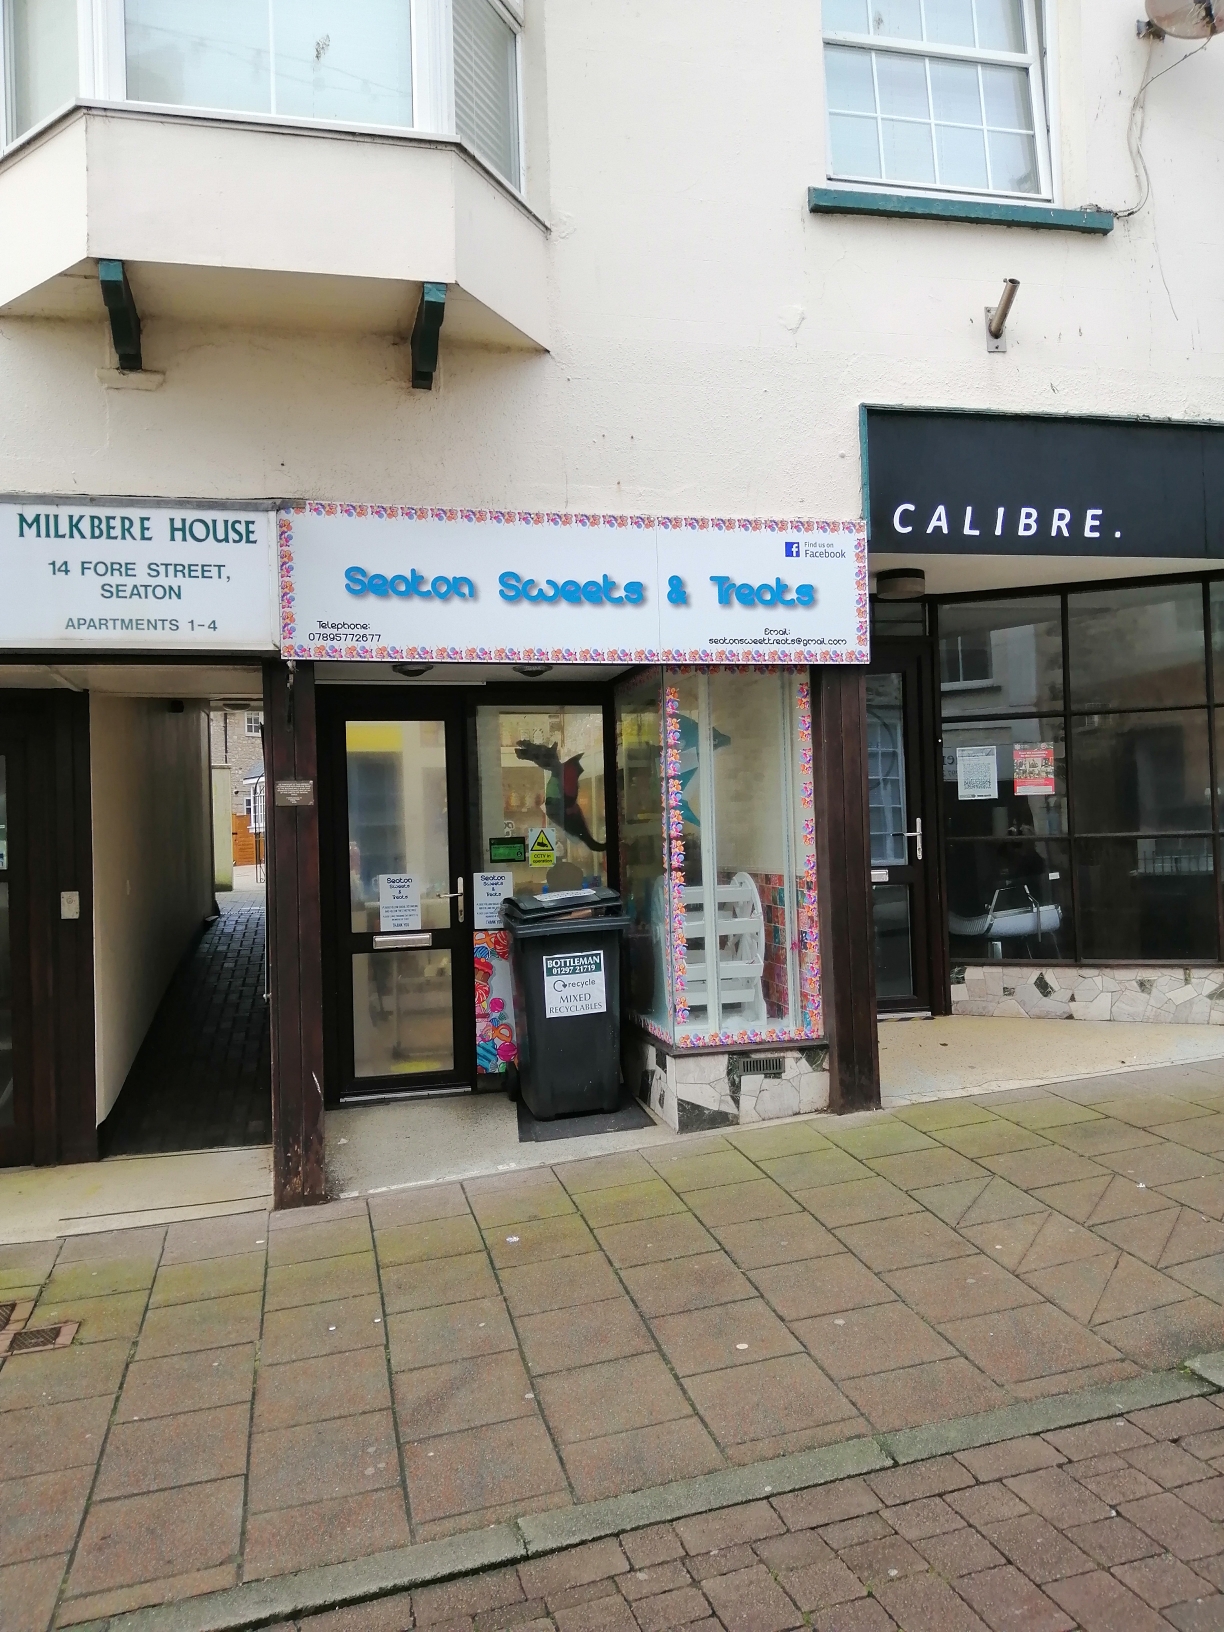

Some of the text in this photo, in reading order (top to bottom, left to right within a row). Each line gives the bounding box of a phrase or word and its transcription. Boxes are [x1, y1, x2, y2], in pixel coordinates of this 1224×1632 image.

[893, 503, 1122, 538] CALIBRE.
[17, 512, 258, 544] MILKBERE HOUSE
[804, 549, 846, 559] Facebook
[48, 560, 231, 582] 14 FORE STREET,
[100, 583, 182, 600] SEATON
[344, 565, 815, 606] Seaton Sweets & Treats
[65, 617, 218, 631] APARTMENTS 1-4
[316, 620, 371, 631] Telephone:
[308, 632, 381, 642] 07895772677
[763, 628, 791, 636] Email:
[708, 637, 847, 647] seatonsweettreats@gmail.com
[547, 955, 600, 968] BOTTLEMAN
[552, 964, 596, 975] 01297 21719
[568, 978, 596, 988] recycle
[559, 992, 592, 1004] MIXED
[549, 1001, 603, 1014] RECYCLABLES
